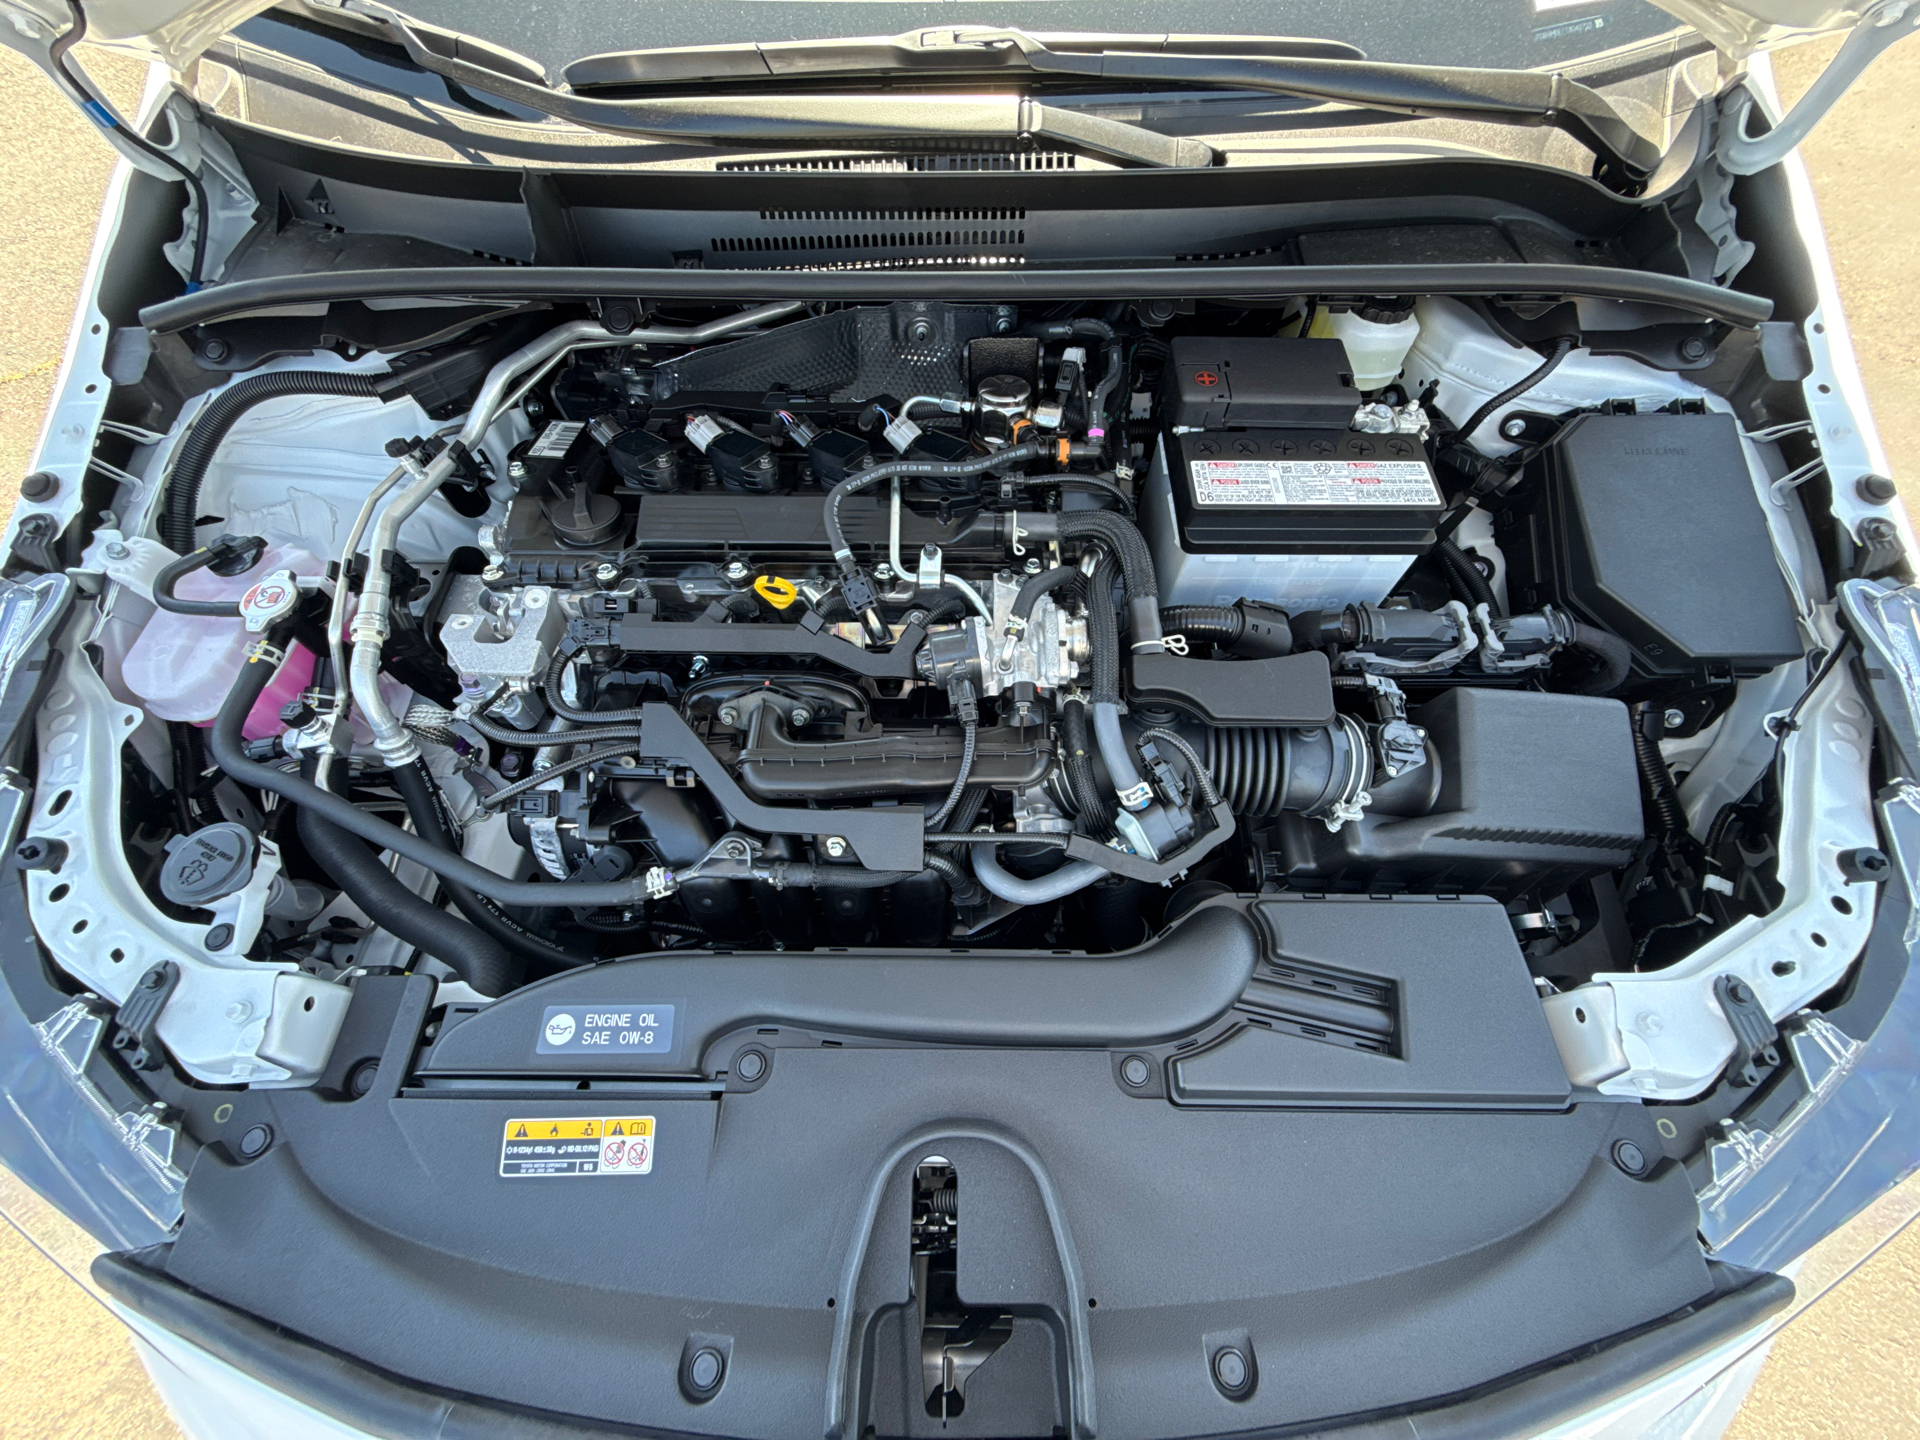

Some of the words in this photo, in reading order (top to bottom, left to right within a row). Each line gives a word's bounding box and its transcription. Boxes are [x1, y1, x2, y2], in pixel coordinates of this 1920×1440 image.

[1200, 492, 1214, 502] D6
[1214, 594, 1340, 608] Psonic
[526, 932, 556, 949] YOKOHAMA
[584, 1014, 632, 1027] ENGINE
[639, 1014, 659, 1026] OIL
[582, 1031, 611, 1044] SAE
[620, 1031, 654, 1044] 0W-8
